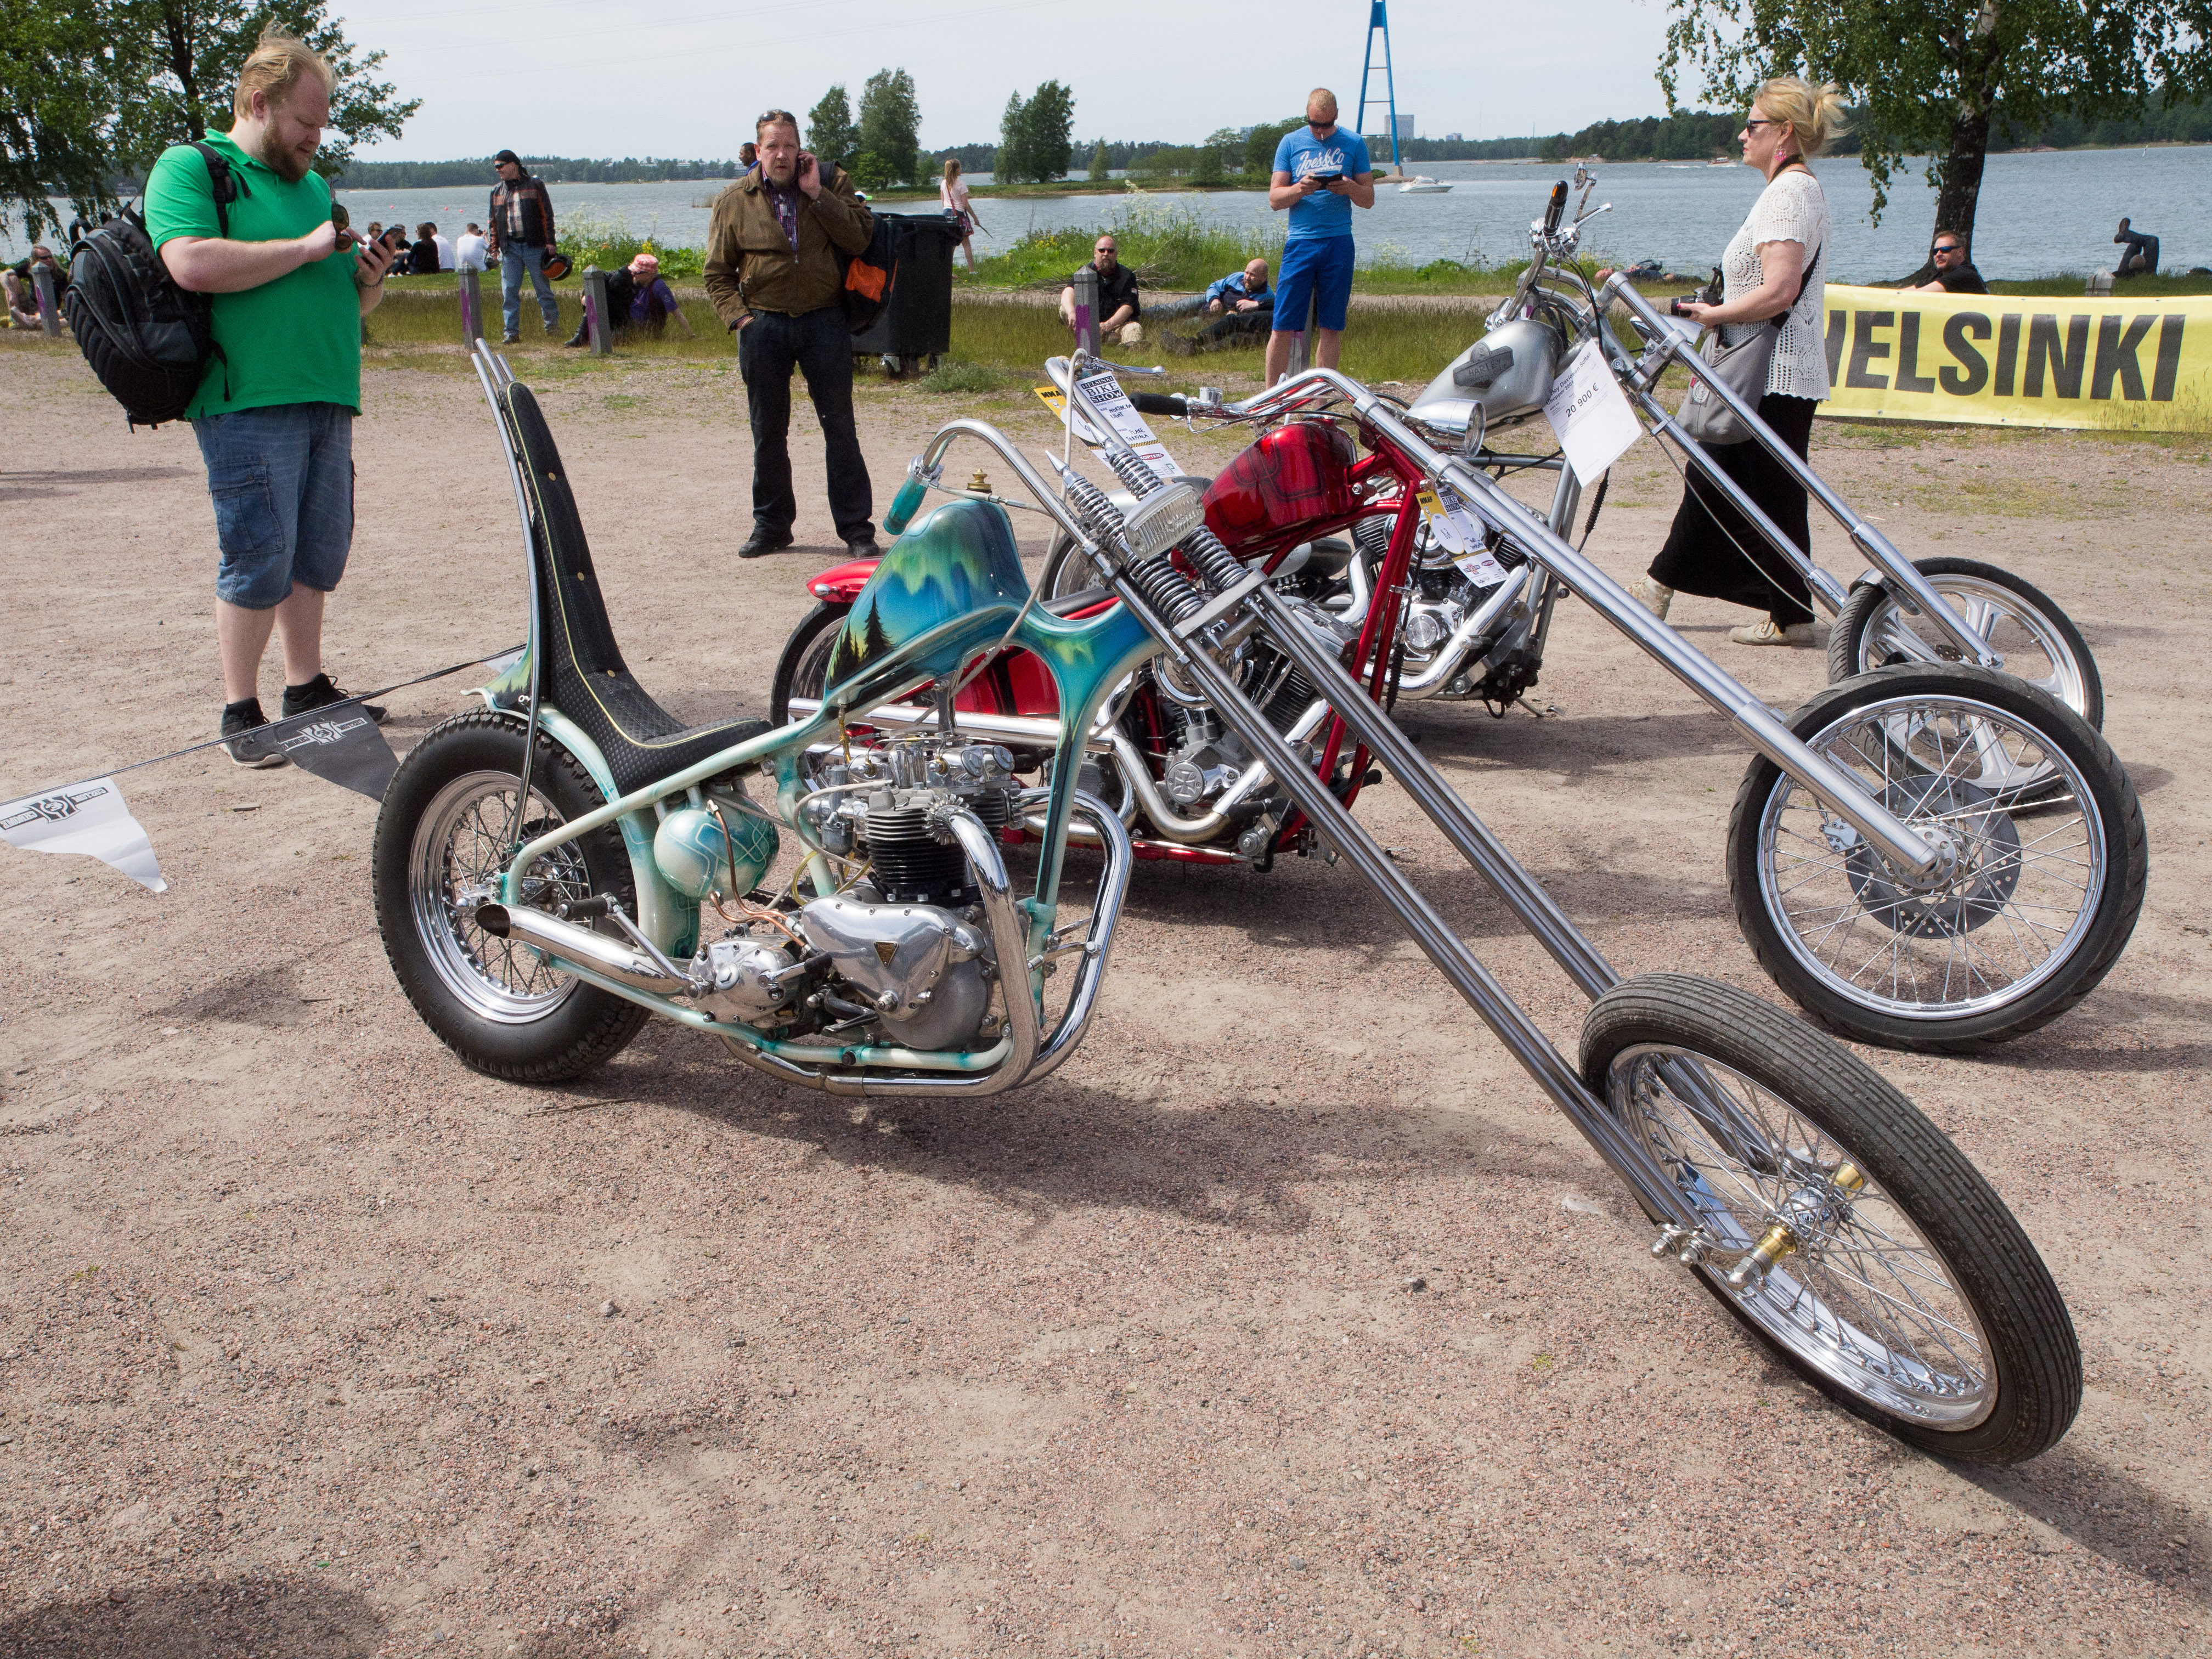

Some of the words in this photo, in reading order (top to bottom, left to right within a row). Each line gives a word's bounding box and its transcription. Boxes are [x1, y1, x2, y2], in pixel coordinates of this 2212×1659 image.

[1082, 376, 1113, 390] HELSINKI
[1086, 382, 1119, 396] BIKE
[1091, 390, 1123, 404] SHOW
[1566, 404, 1577, 418] 20
[1577, 390, 1593, 407] 900
[1592, 382, 1599, 392] €
[1442, 495, 1458, 505] BIKE
[1445, 503, 1460, 512] SHOW
